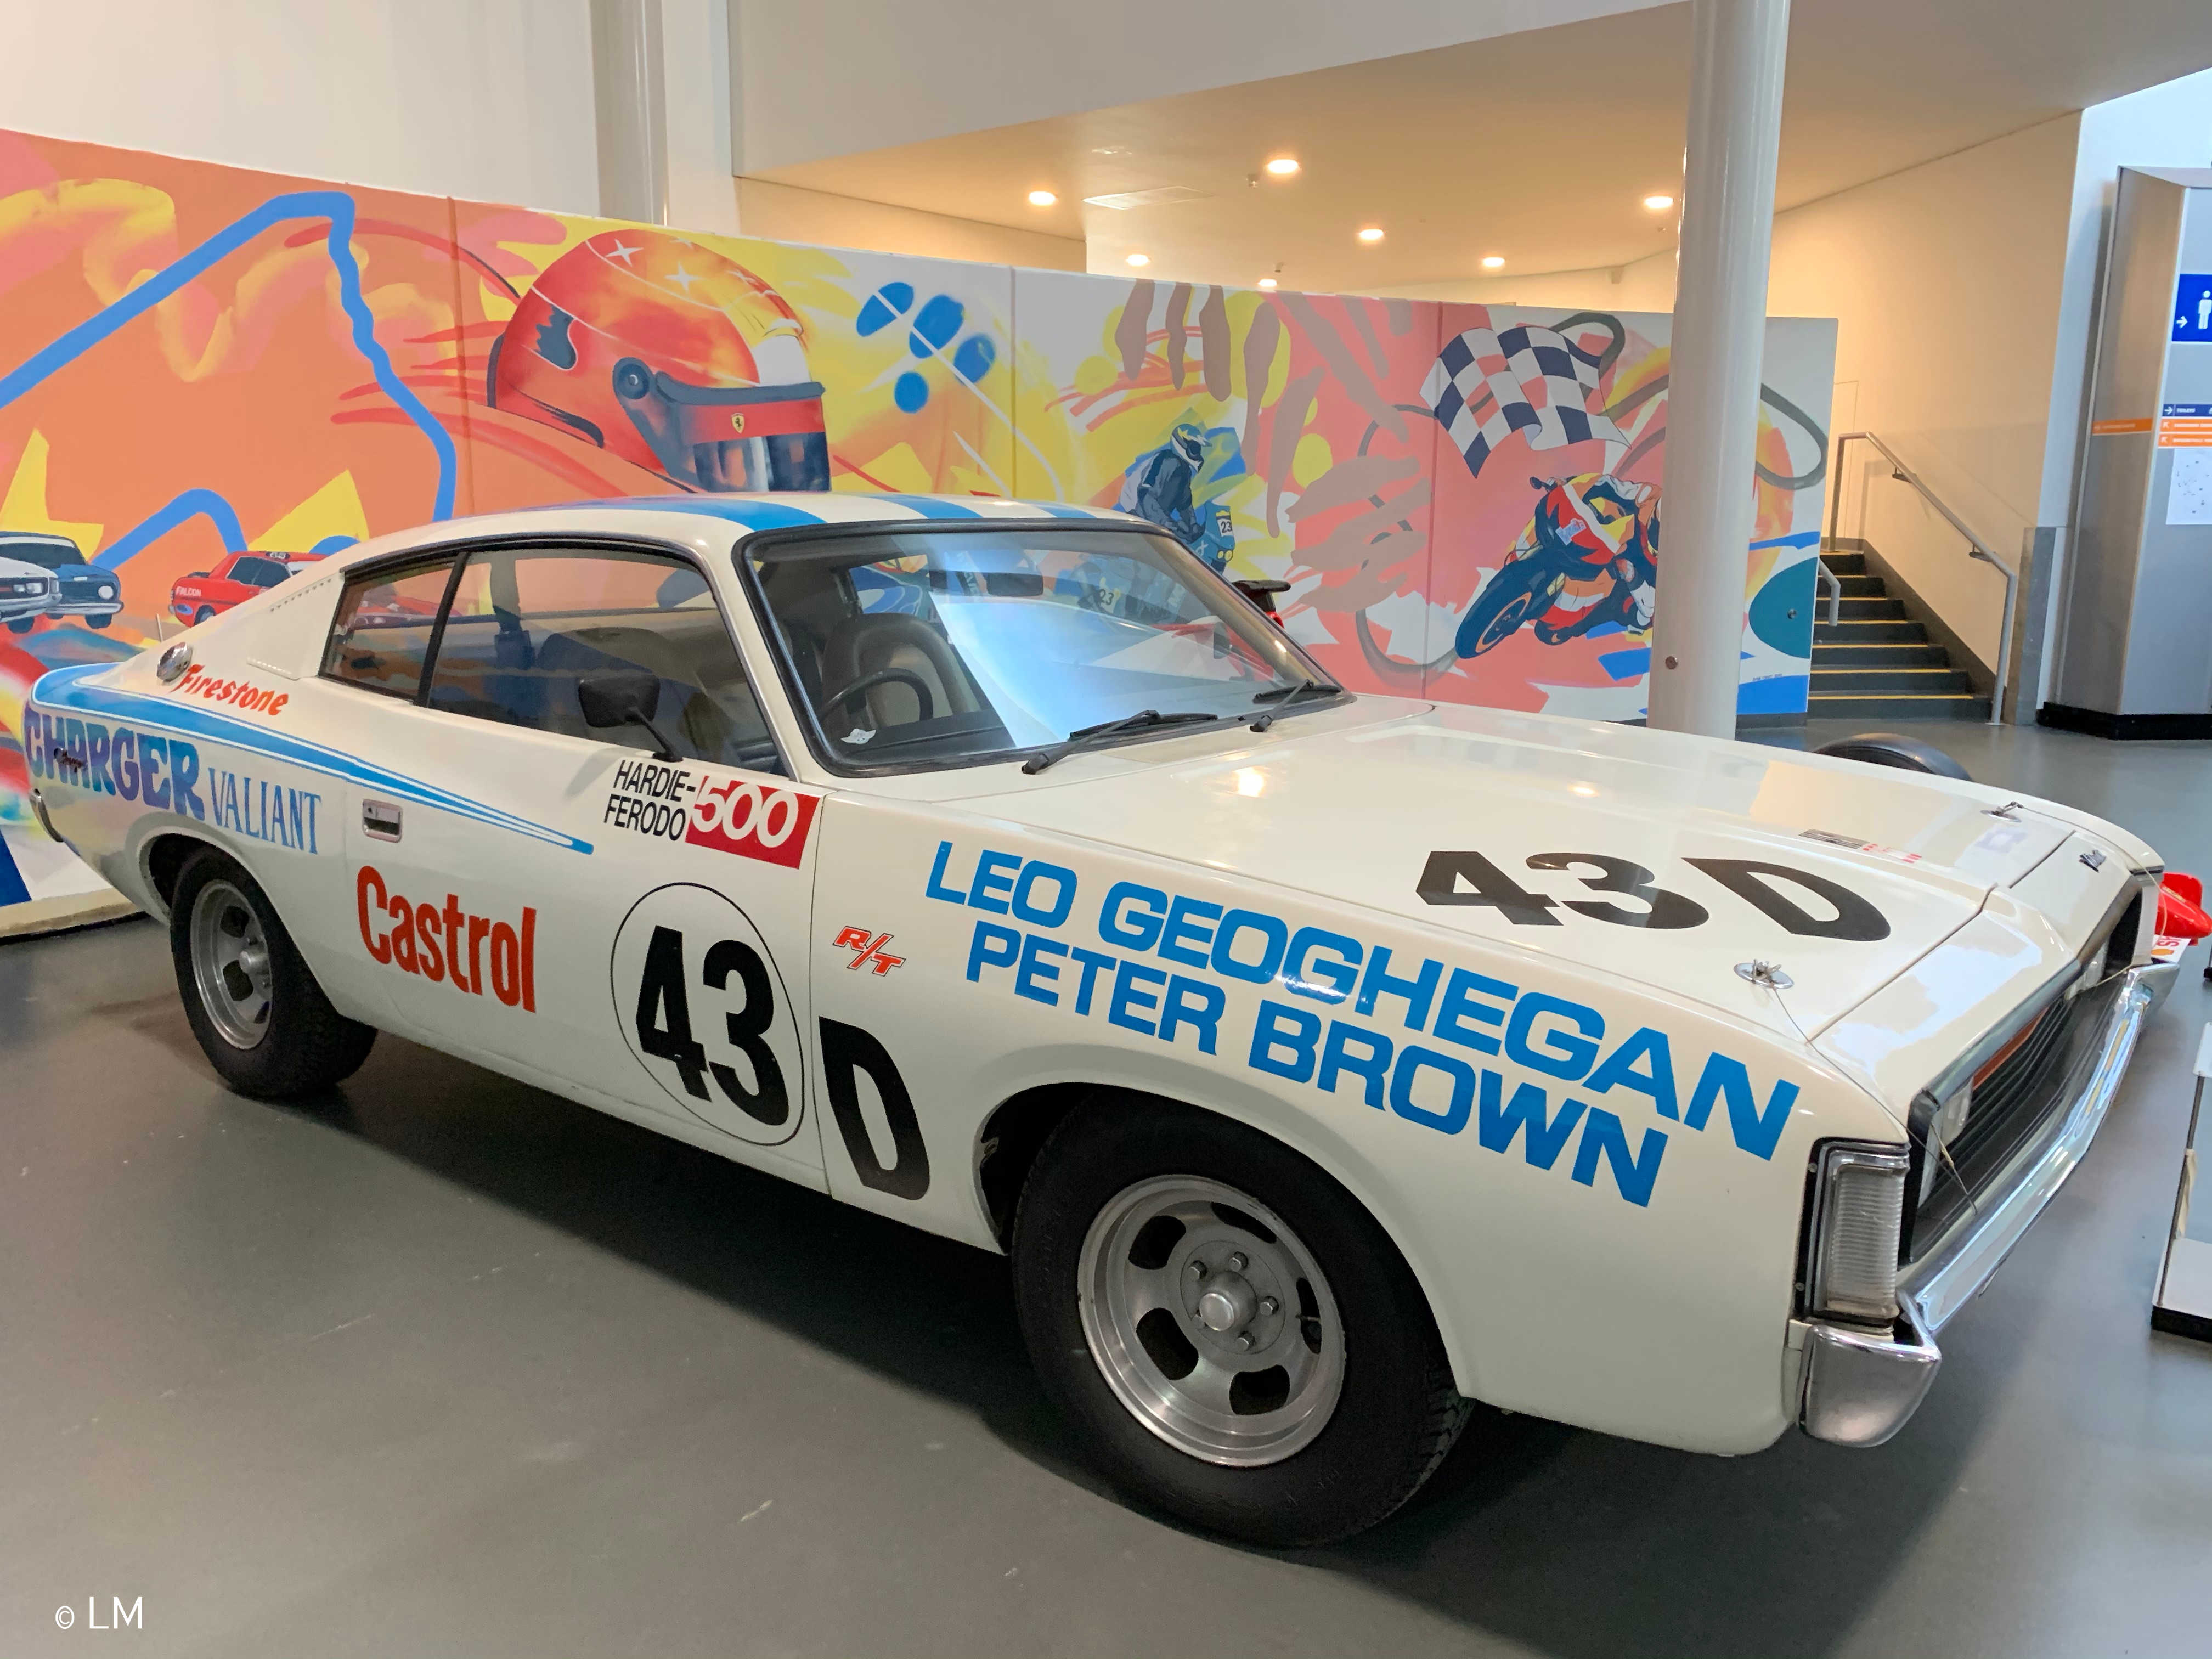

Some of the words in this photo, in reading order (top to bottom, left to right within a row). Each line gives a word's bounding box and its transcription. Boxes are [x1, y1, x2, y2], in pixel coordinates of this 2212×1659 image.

[1221, 521, 1233, 533] 23
[167, 664, 289, 715] Firestone
[24, 700, 205, 821] CHARGER
[208, 767, 321, 854] VALIANT
[603, 793, 686, 841] FERODO
[613, 760, 697, 802] HARDIE-
[691, 775, 799, 848] 500
[1415, 850, 1709, 929] 43
[1681, 857, 1891, 941] D
[357, 865, 537, 1014] Castrol
[832, 925, 906, 977] R/T
[926, 840, 1077, 928] LEO
[1098, 881, 1801, 1161] GEOGHEGAN
[636, 925, 790, 1126] 43
[819, 1015, 930, 1201] D
[966, 920, 1227, 1056] PETER
[1248, 1000, 1669, 1208] BROWN
